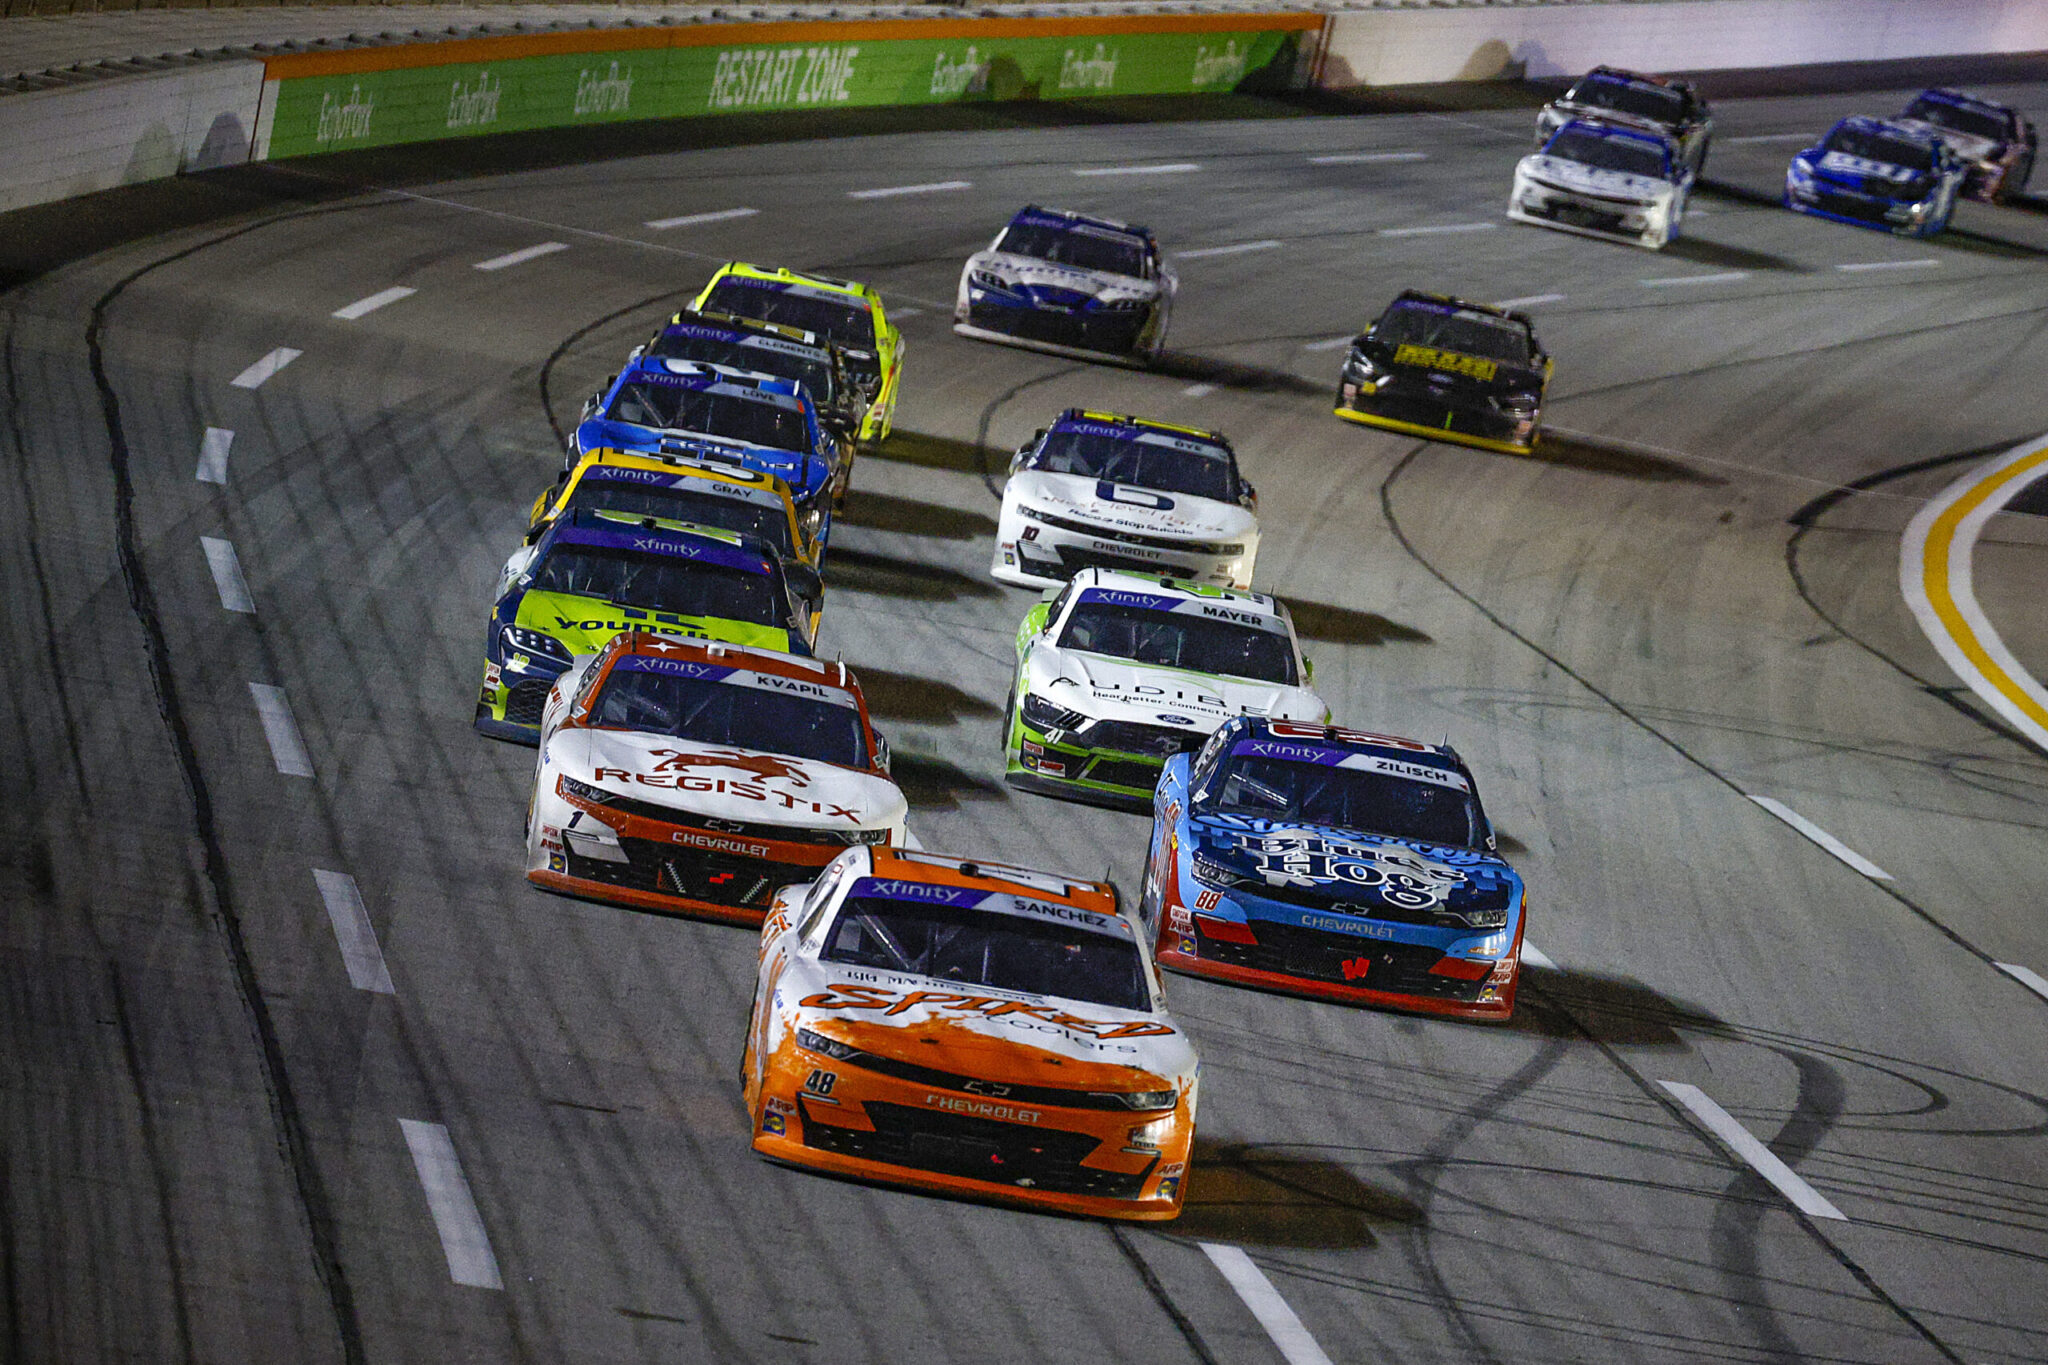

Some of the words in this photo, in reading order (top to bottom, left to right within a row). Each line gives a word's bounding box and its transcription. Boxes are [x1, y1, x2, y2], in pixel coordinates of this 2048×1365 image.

[708, 49, 803, 107] RESTART
[797, 47, 860, 104] ZONE
[641, 373, 697, 388] xfinity
[742, 388, 777, 402] LOVE
[1071, 423, 1128, 439] xfinity
[600, 466, 662, 484] xfinity
[712, 483, 753, 498] GRAY
[633, 538, 701, 557] xfinity
[1092, 541, 1162, 560] CHEVROLET
[1097, 591, 1162, 607] xfinity
[1203, 606, 1263, 626] MAYER
[634, 658, 711, 677] xfinity
[757, 675, 829, 698] KVAPIL
[1162, 714, 1190, 725] Ford
[1044, 728, 1066, 745] 41
[1251, 742, 1326, 762] xfinity
[1376, 760, 1449, 782] ZILISCH
[594, 767, 862, 826] REGISTIX
[568, 811, 585, 829] 1
[671, 831, 770, 858] CHEVROLET
[1233, 832, 1468, 883] Blues
[1256, 848, 1439, 910] Hog
[871, 880, 962, 902] xfinity
[1194, 890, 1223, 912] 88
[1014, 899, 1108, 929] SANCHEZ
[1301, 914, 1396, 939] CHEVROLET
[805, 1069, 837, 1096] 48
[926, 1093, 1042, 1123] CHEVROLET
